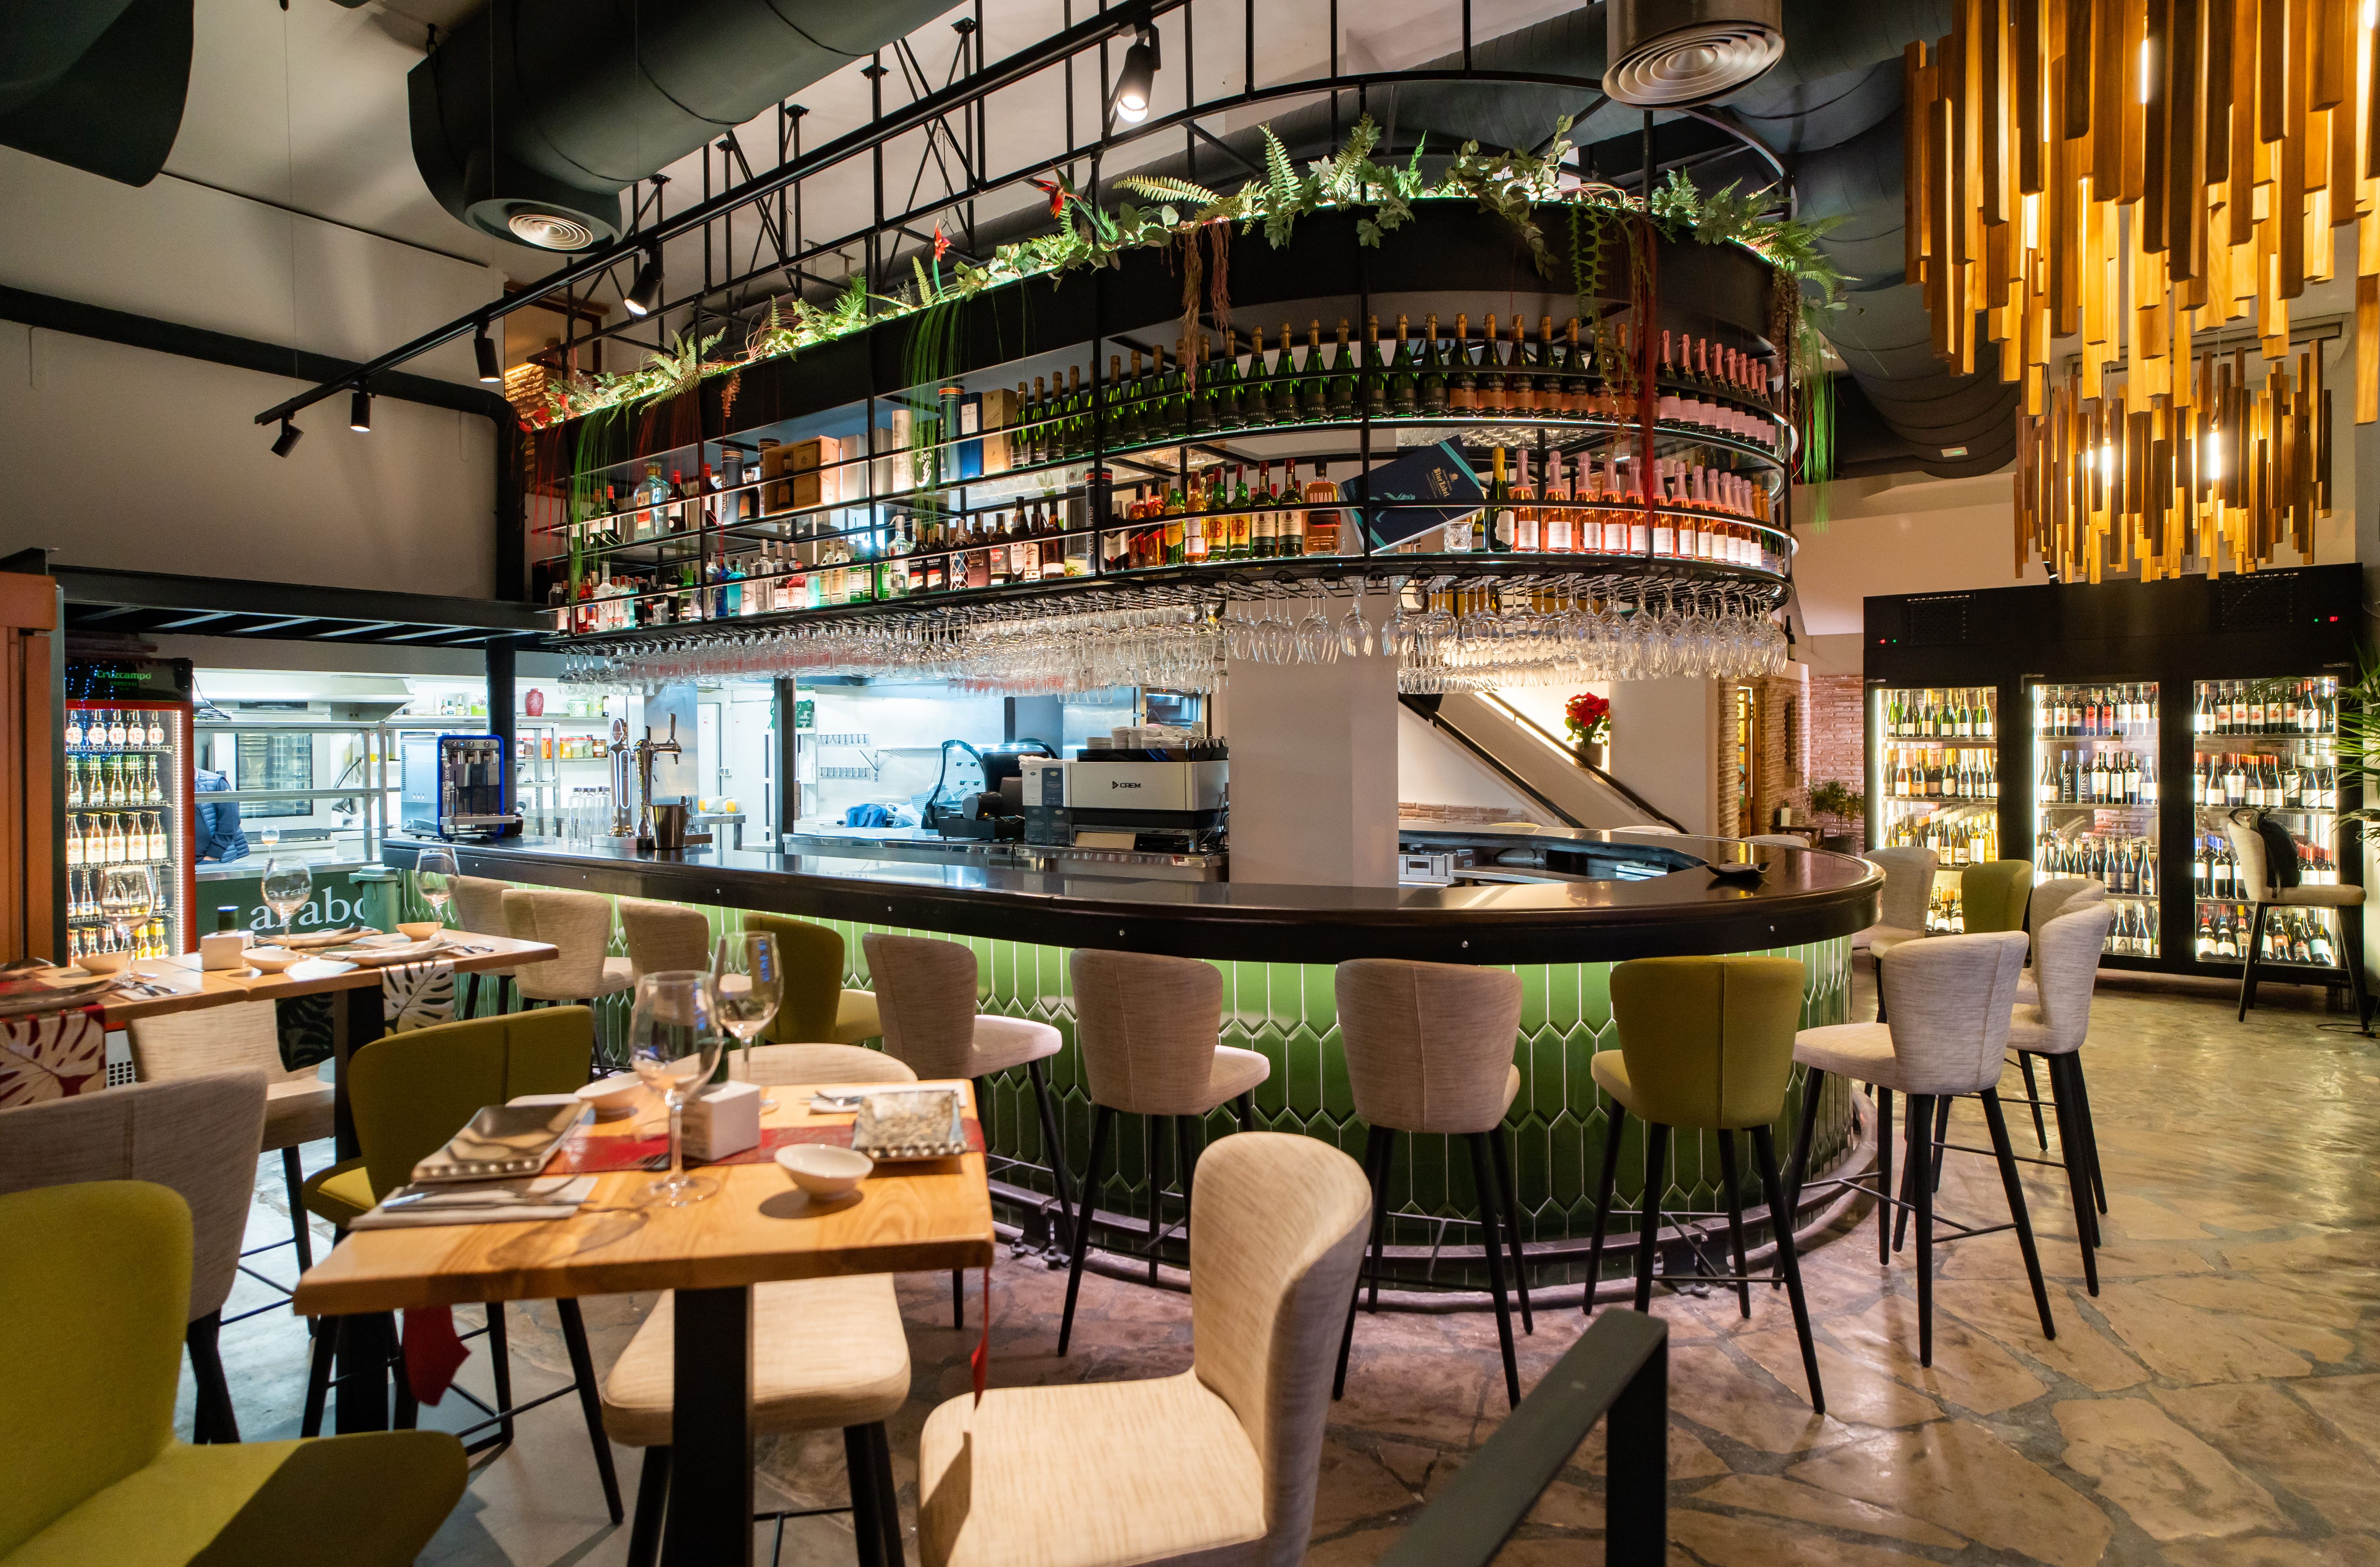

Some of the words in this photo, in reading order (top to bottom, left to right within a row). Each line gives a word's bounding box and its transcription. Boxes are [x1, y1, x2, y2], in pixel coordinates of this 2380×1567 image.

[1433, 467, 1443, 482] Blue
[1438, 480, 1450, 497] Label
[1309, 492, 1332, 503] NOMAD
[1207, 521, 1223, 539] J&B
[1230, 519, 1245, 537] J&B
[97, 670, 151, 680] Cruzcampo
